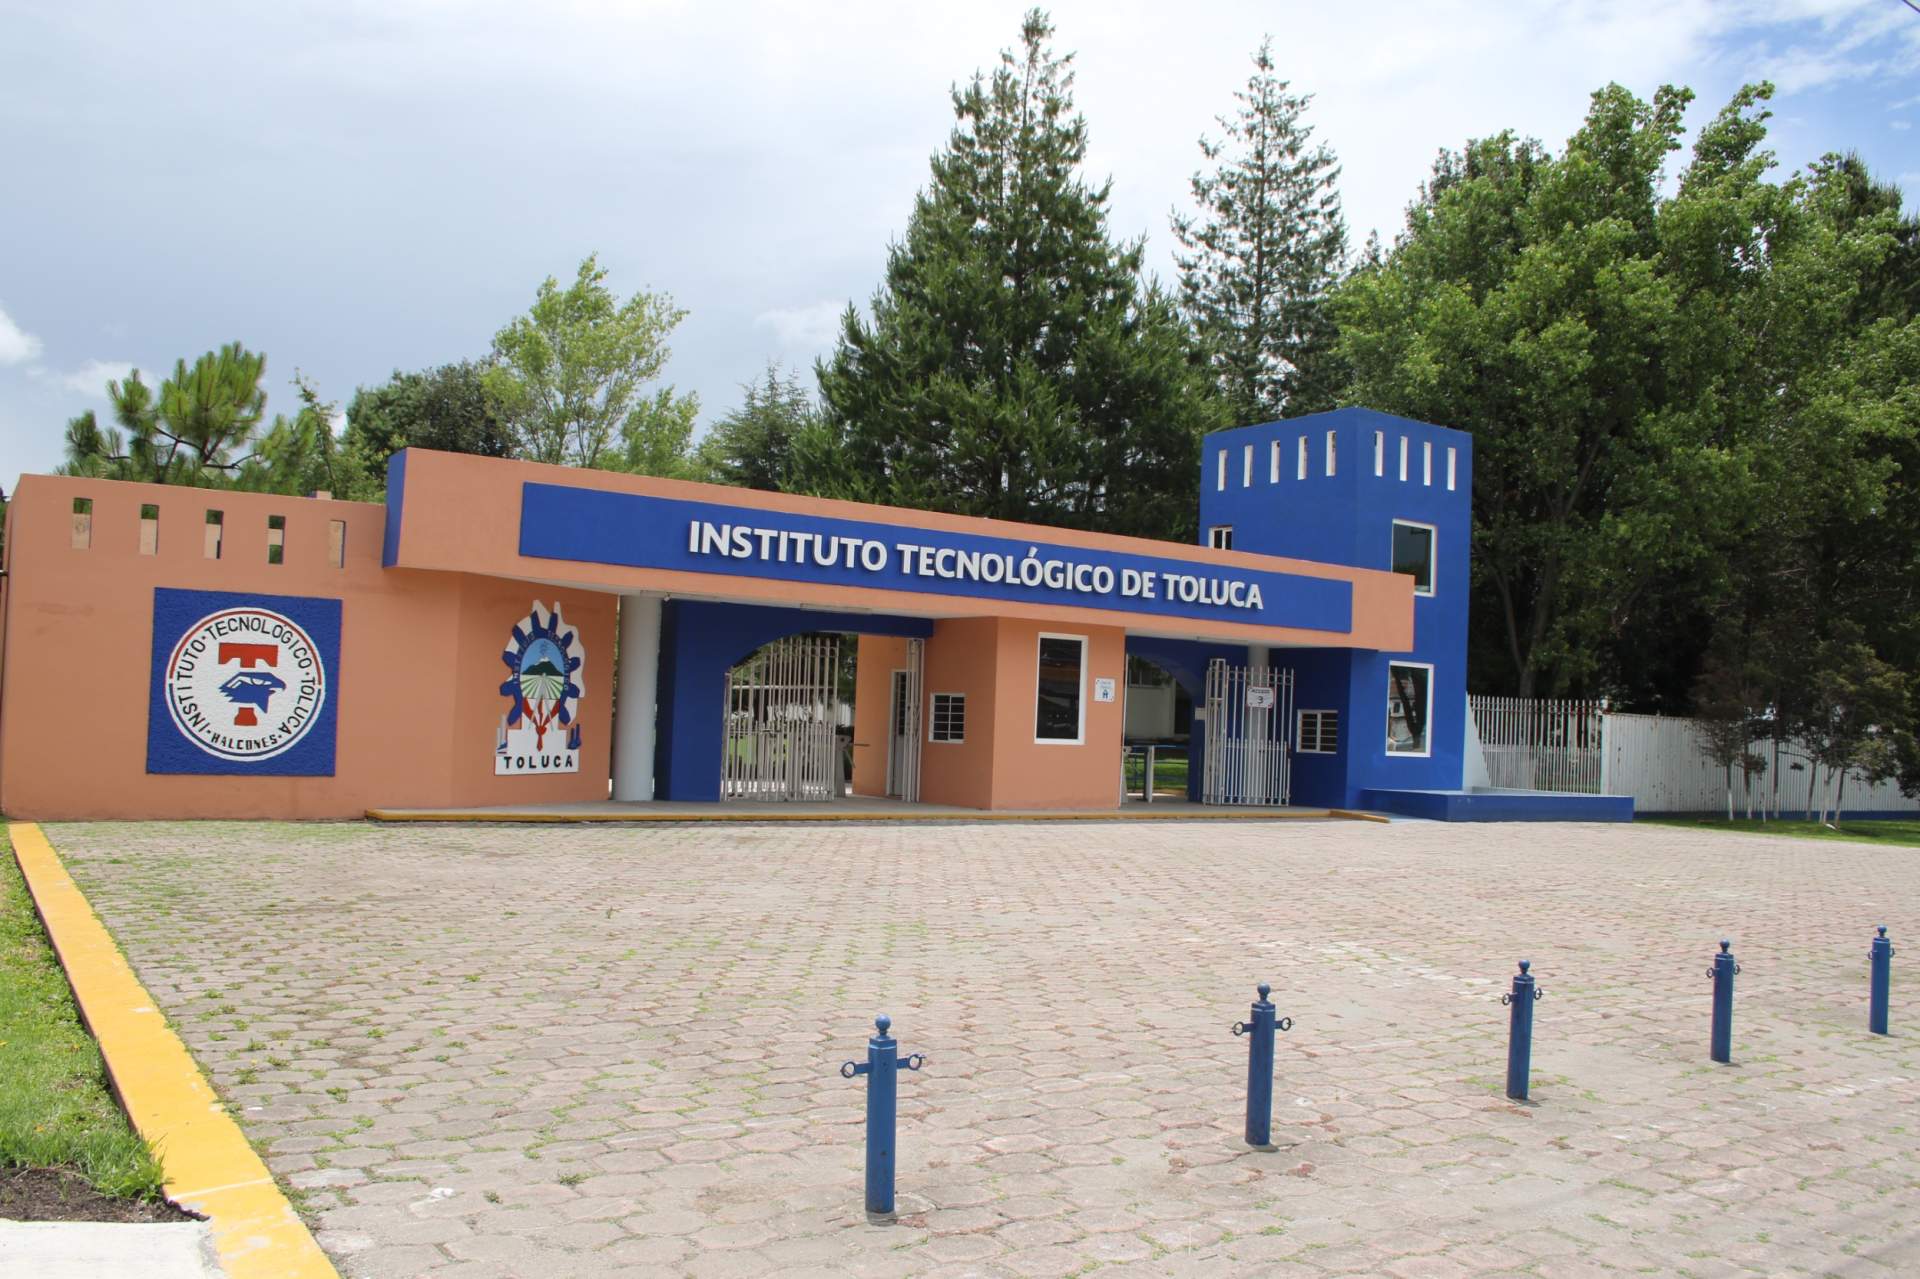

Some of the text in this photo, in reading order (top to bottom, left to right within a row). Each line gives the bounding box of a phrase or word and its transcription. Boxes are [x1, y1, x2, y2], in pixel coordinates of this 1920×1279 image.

[689, 520, 1265, 610] INSTITUTO TECNOLÓGICO DE TOLUCA
[177, 639, 211, 732] INSTITUTO
[278, 676, 316, 735] TOLUCA
[1257, 695, 1264, 704] 3
[211, 732, 278, 751] HALCONES
[503, 755, 573, 769] TOLUCA
